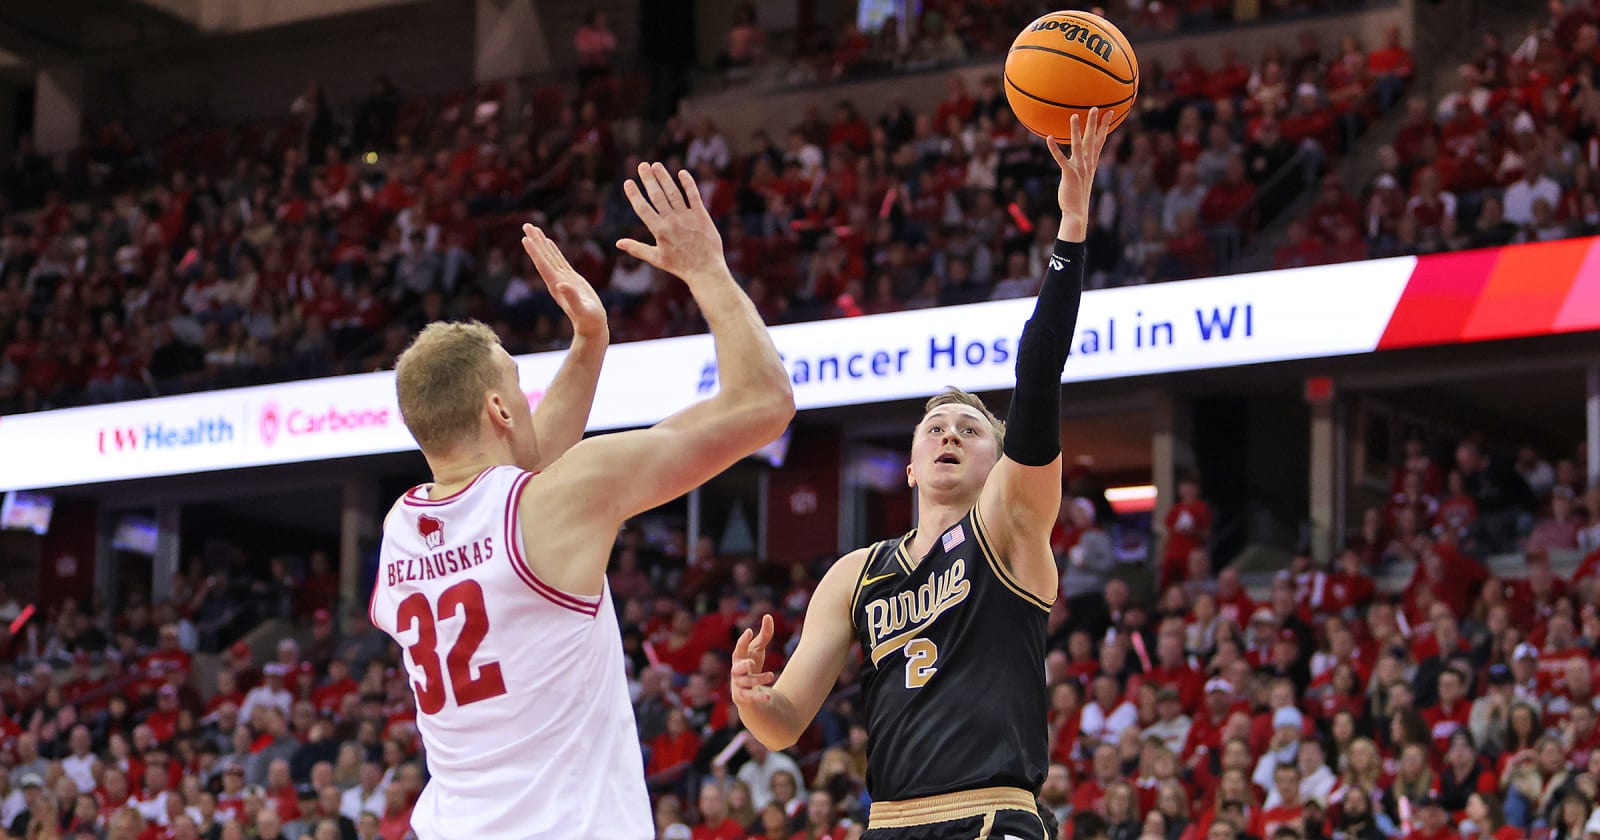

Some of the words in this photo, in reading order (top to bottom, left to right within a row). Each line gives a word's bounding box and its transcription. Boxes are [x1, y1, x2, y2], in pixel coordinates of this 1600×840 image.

[1031, 20, 1114, 63] Wilson
[780, 350, 909, 385] ancer
[928, 318, 1115, 370] Hosal
[1136, 311, 1174, 348] in
[1195, 304, 1252, 341] WI
[286, 405, 389, 436] Carbone
[387, 537, 494, 587] BELIAUSKAS
[865, 558, 971, 650] Purdue
[396, 578, 507, 715] 32
[903, 637, 938, 689] 2
